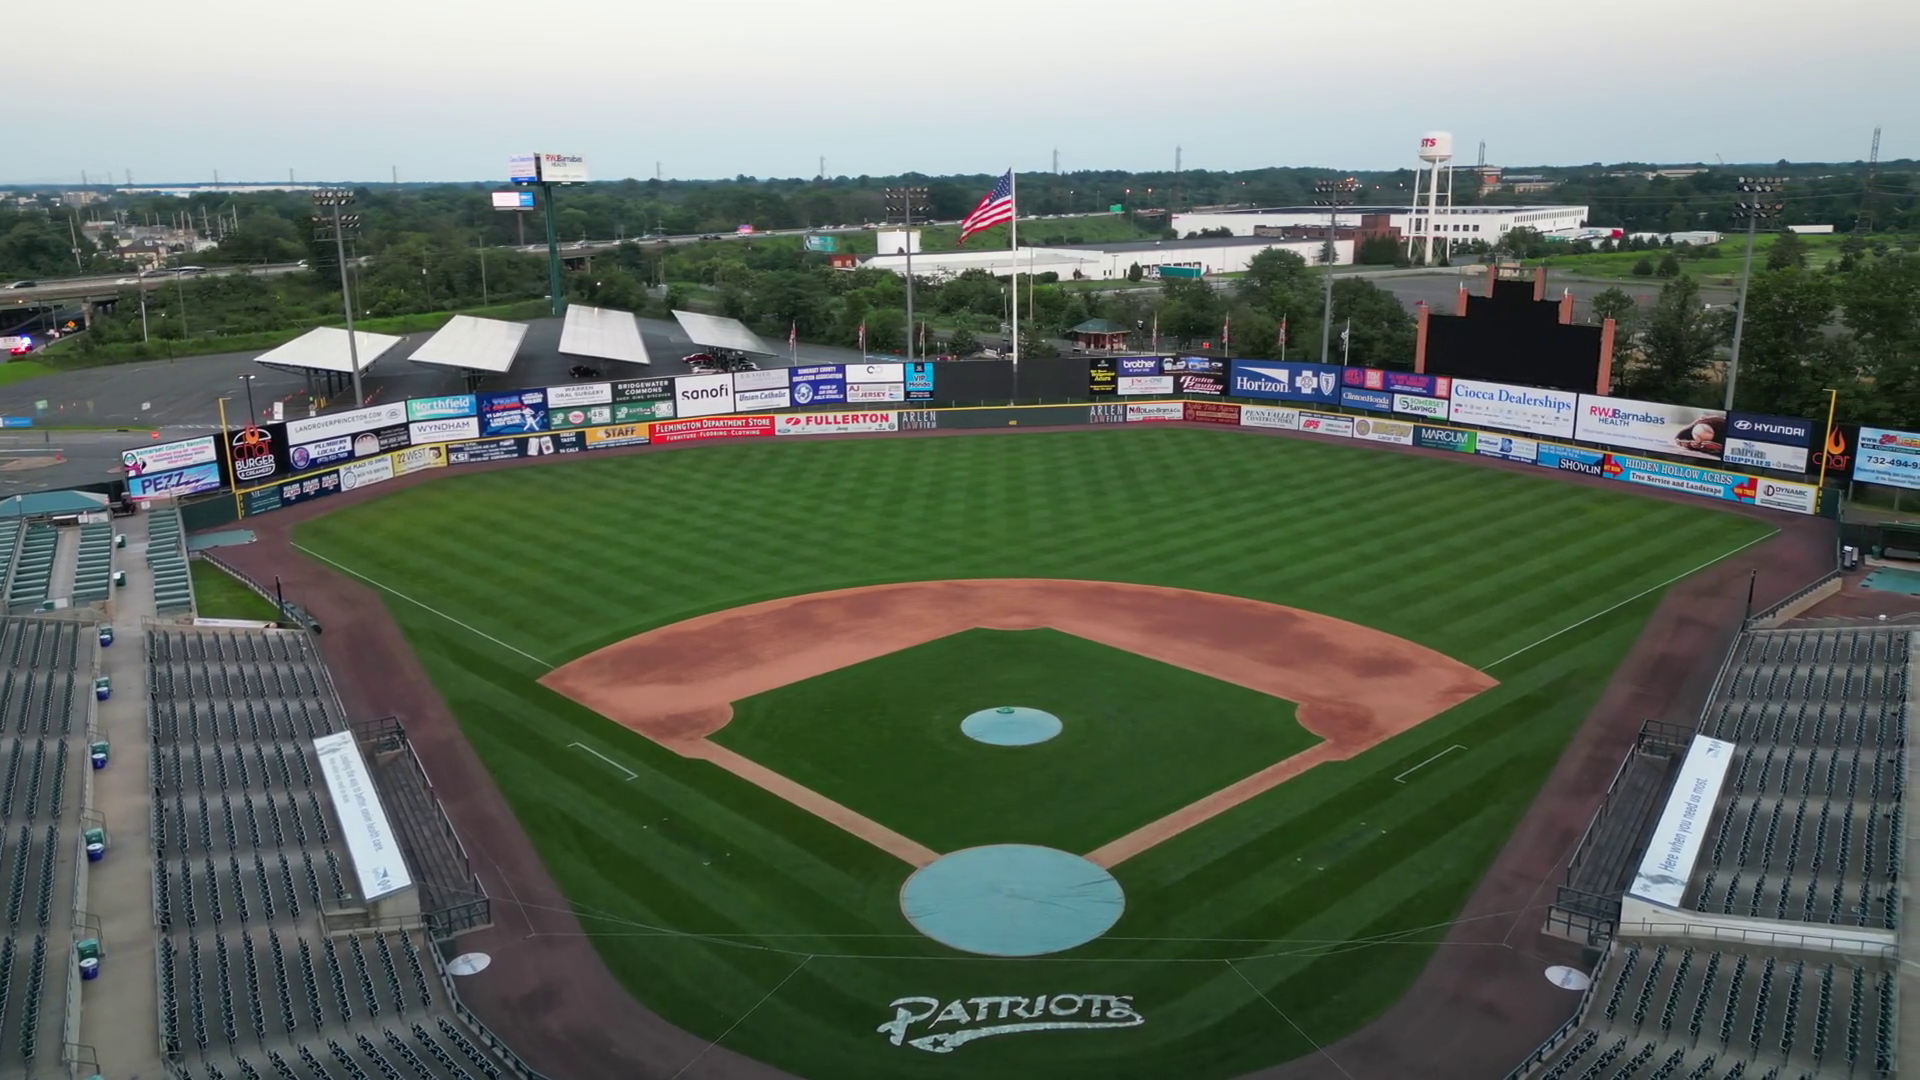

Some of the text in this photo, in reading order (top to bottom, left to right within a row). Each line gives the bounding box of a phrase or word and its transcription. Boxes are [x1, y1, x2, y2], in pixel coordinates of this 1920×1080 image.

[1123, 360, 1156, 368] brother
[618, 380, 669, 390] BRIDGEWATER
[1236, 377, 1289, 392] Horizon
[625, 387, 663, 395] COMMONS
[682, 384, 728, 400] sanofi
[739, 390, 786, 401] Union Catholic
[413, 397, 470, 411] Northfield
[1410, 398, 1445, 408] SOMERSET
[1455, 384, 1494, 401] Ciocca
[1498, 389, 1572, 413] Dealerships
[1090, 405, 1123, 416] ARLEN
[1268, 411, 1295, 419] VALLEY
[1410, 405, 1437, 414] SAVINGS
[1590, 405, 1665, 425] RWJBarnabas
[295, 411, 382, 433] LANDROVERPRINCETON.COM
[806, 413, 889, 425] FULLERTON
[902, 411, 936, 422] ARLEN
[1598, 417, 1629, 427] HEALTH
[417, 421, 470, 432] WYNDHAM
[656, 418, 770, 433] FLEMINGTON DEPARTMENT STORE
[902, 422, 918, 430] LAW
[1303, 420, 1321, 429] GPS
[1754, 422, 1805, 437] HYUNDAI
[604, 427, 636, 438] STAFF
[667, 433, 696, 441] FURNITURE
[1422, 428, 1468, 443] MARCUM
[314, 439, 348, 450] PLUMBERS
[398, 448, 426, 464] 22 WEST
[451, 453, 468, 462] KSI
[1730, 448, 1767, 460] EMPIRE
[235, 454, 275, 471] BURGER
[1560, 459, 1600, 475] SHOVLIN
[1724, 455, 1772, 468] SUPPLIES
[1866, 456, 1920, 470] 732-494-9
[246, 466, 272, 477] CREAMERY
[1626, 459, 1733, 484] HIDDEN HOLLOW ACRES
[141, 472, 184, 494] PEZZ
[303, 482, 320, 493] FUN
[322, 478, 338, 488] FUN
[1631, 472, 1722, 495] Tree Service and Landscape
[283, 488, 300, 498] FUN
[1776, 486, 1808, 497] DYNAMIC
[1690, 794, 1702, 804] us
[1683, 801, 1698, 820] need
[1678, 820, 1692, 834] you
[1668, 833, 1687, 854] when
[1658, 853, 1679, 873] Here
[876, 994, 1145, 1046] PATRIOTS
